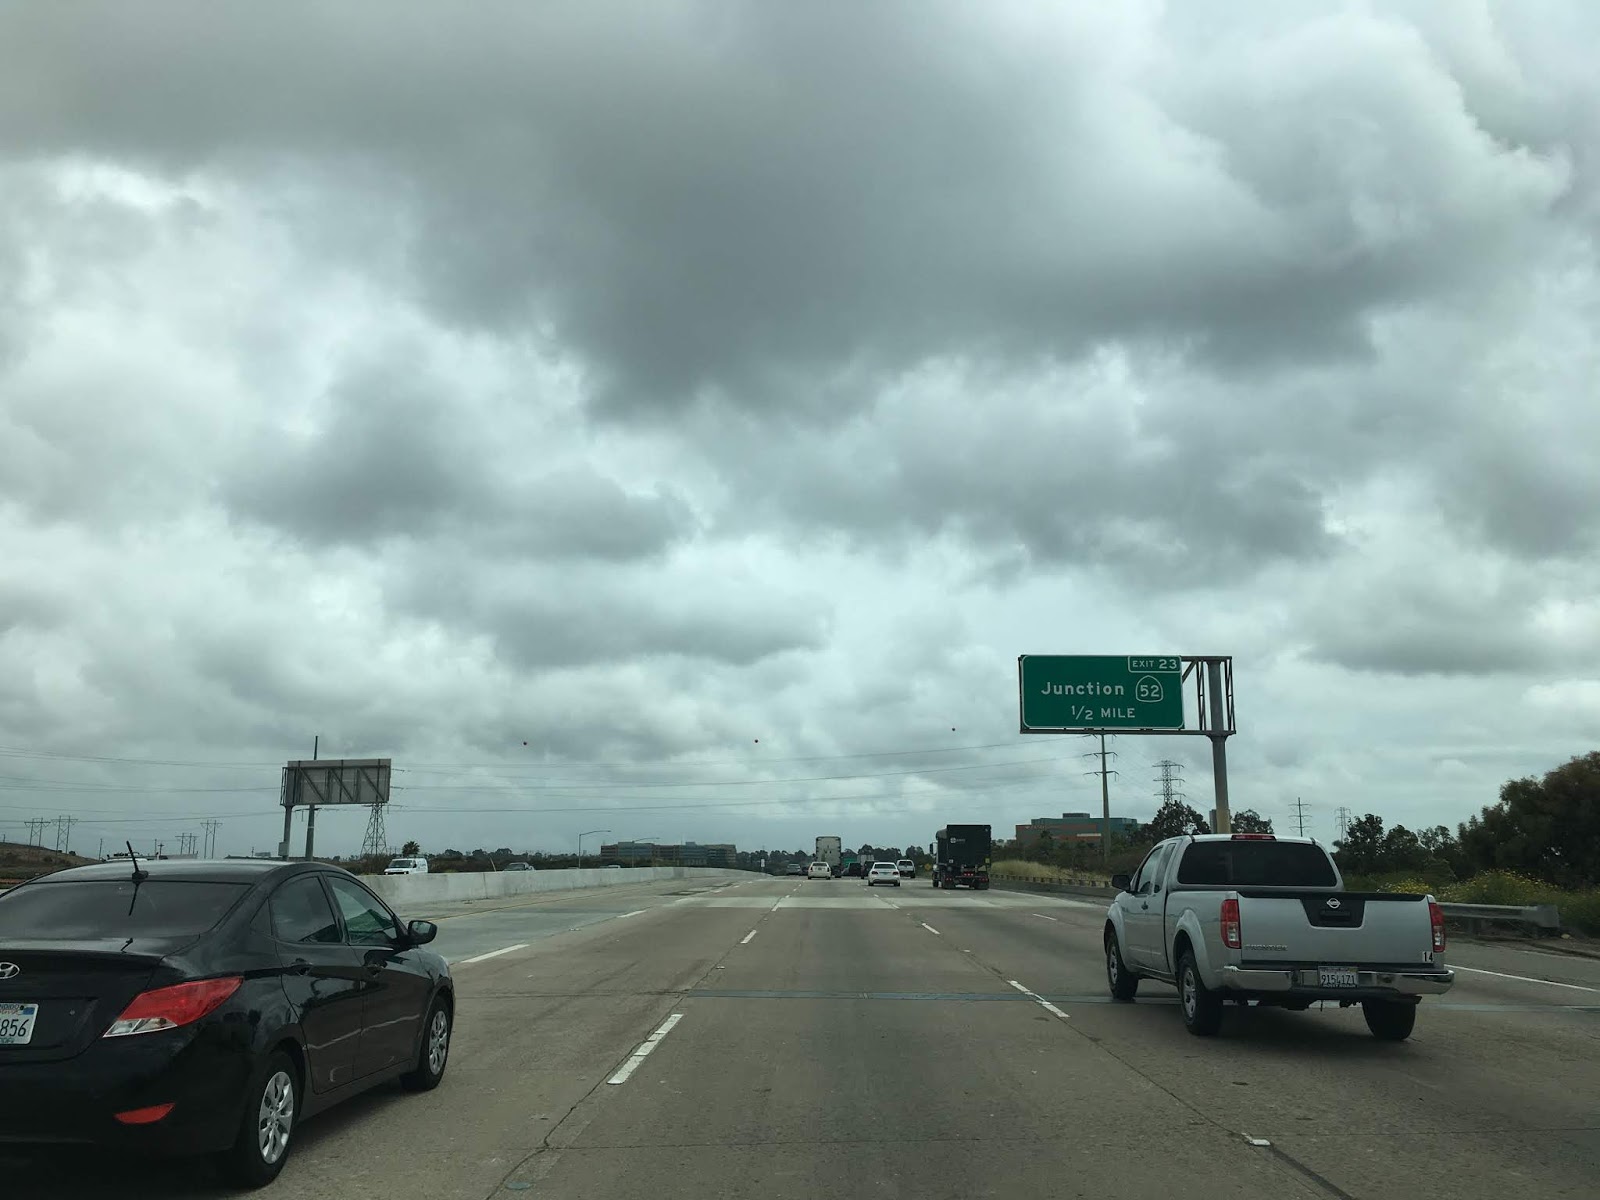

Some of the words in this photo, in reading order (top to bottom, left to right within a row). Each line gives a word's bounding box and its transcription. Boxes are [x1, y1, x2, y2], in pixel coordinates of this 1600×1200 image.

[1132, 660, 1155, 668] EXIT
[1158, 658, 1178, 669] 23
[1040, 681, 1125, 695] Junction
[1139, 684, 1160, 698] 52
[1071, 705, 1094, 720] 1/2
[1100, 707, 1136, 719] MILE
[1423, 951, 1434, 962] 14
[0, 1018, 30, 1037] 856
